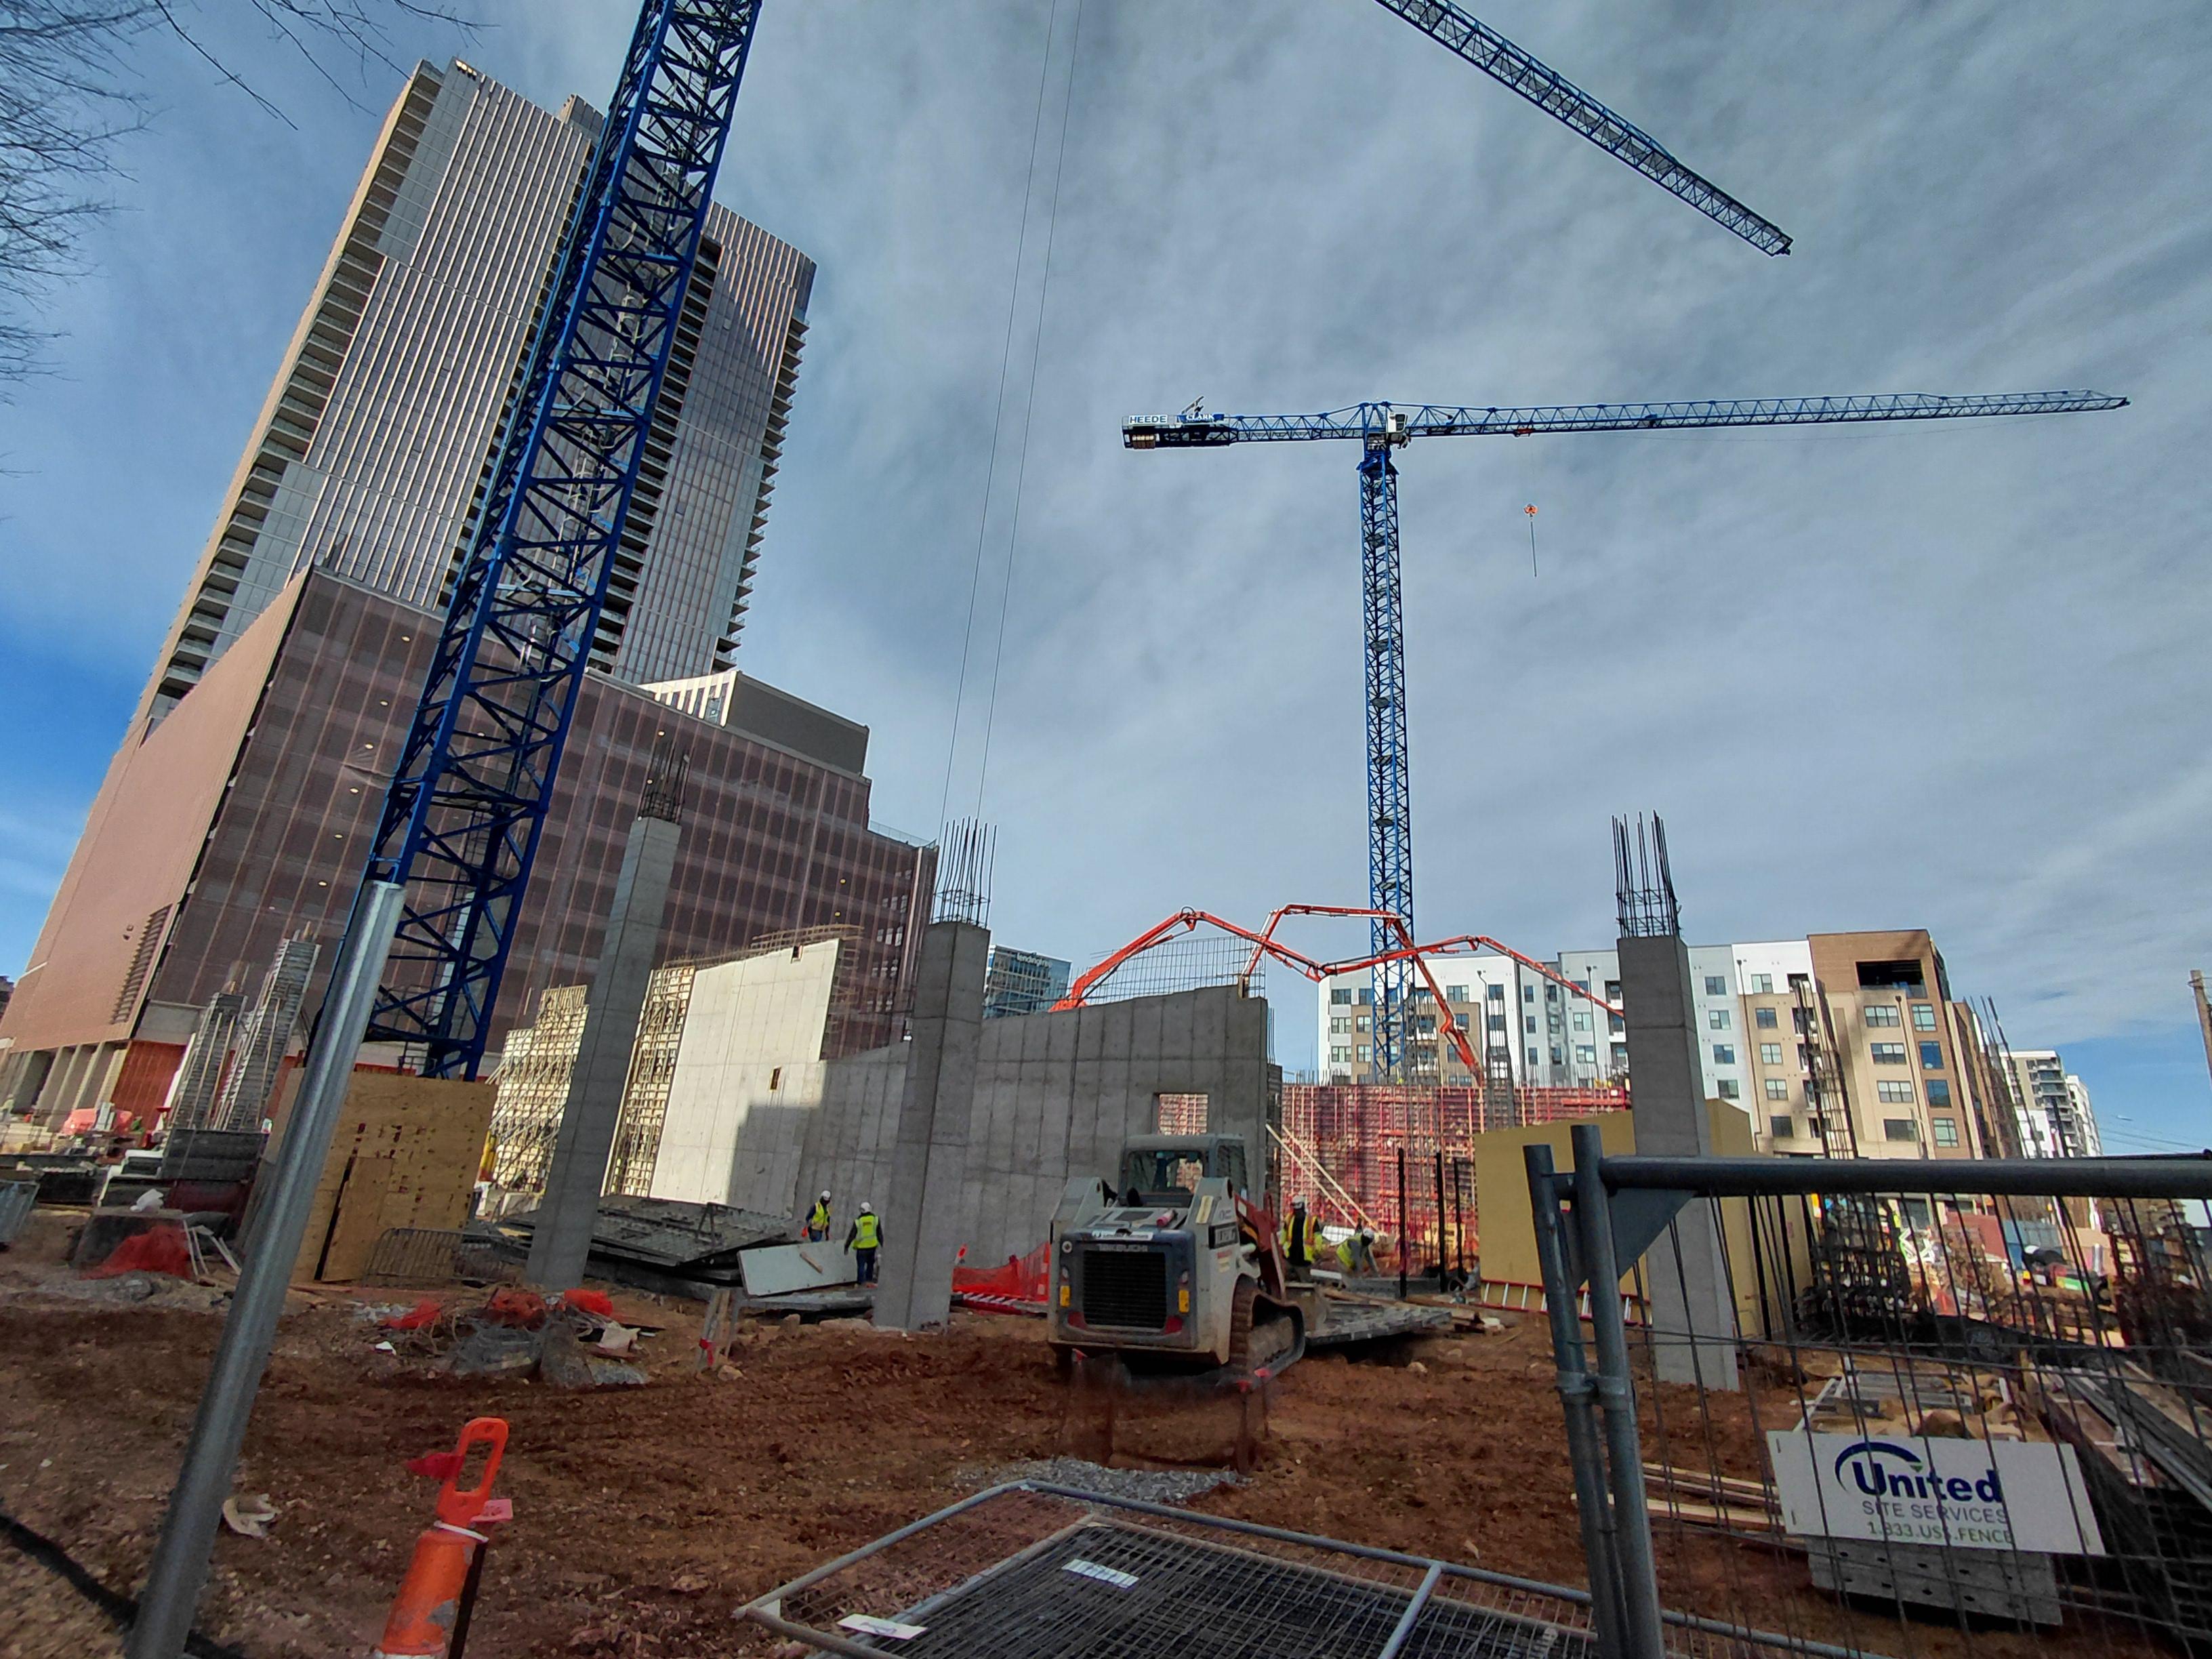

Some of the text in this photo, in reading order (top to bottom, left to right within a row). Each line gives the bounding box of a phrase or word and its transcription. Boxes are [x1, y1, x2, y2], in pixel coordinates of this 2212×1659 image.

[1129, 415, 1166, 424] HEEDE
[1852, 1461, 2005, 1503] United
[1862, 1500, 2007, 1523] SITE SERVICES
[1867, 1521, 2014, 1544] 1.833.US.FENCE
